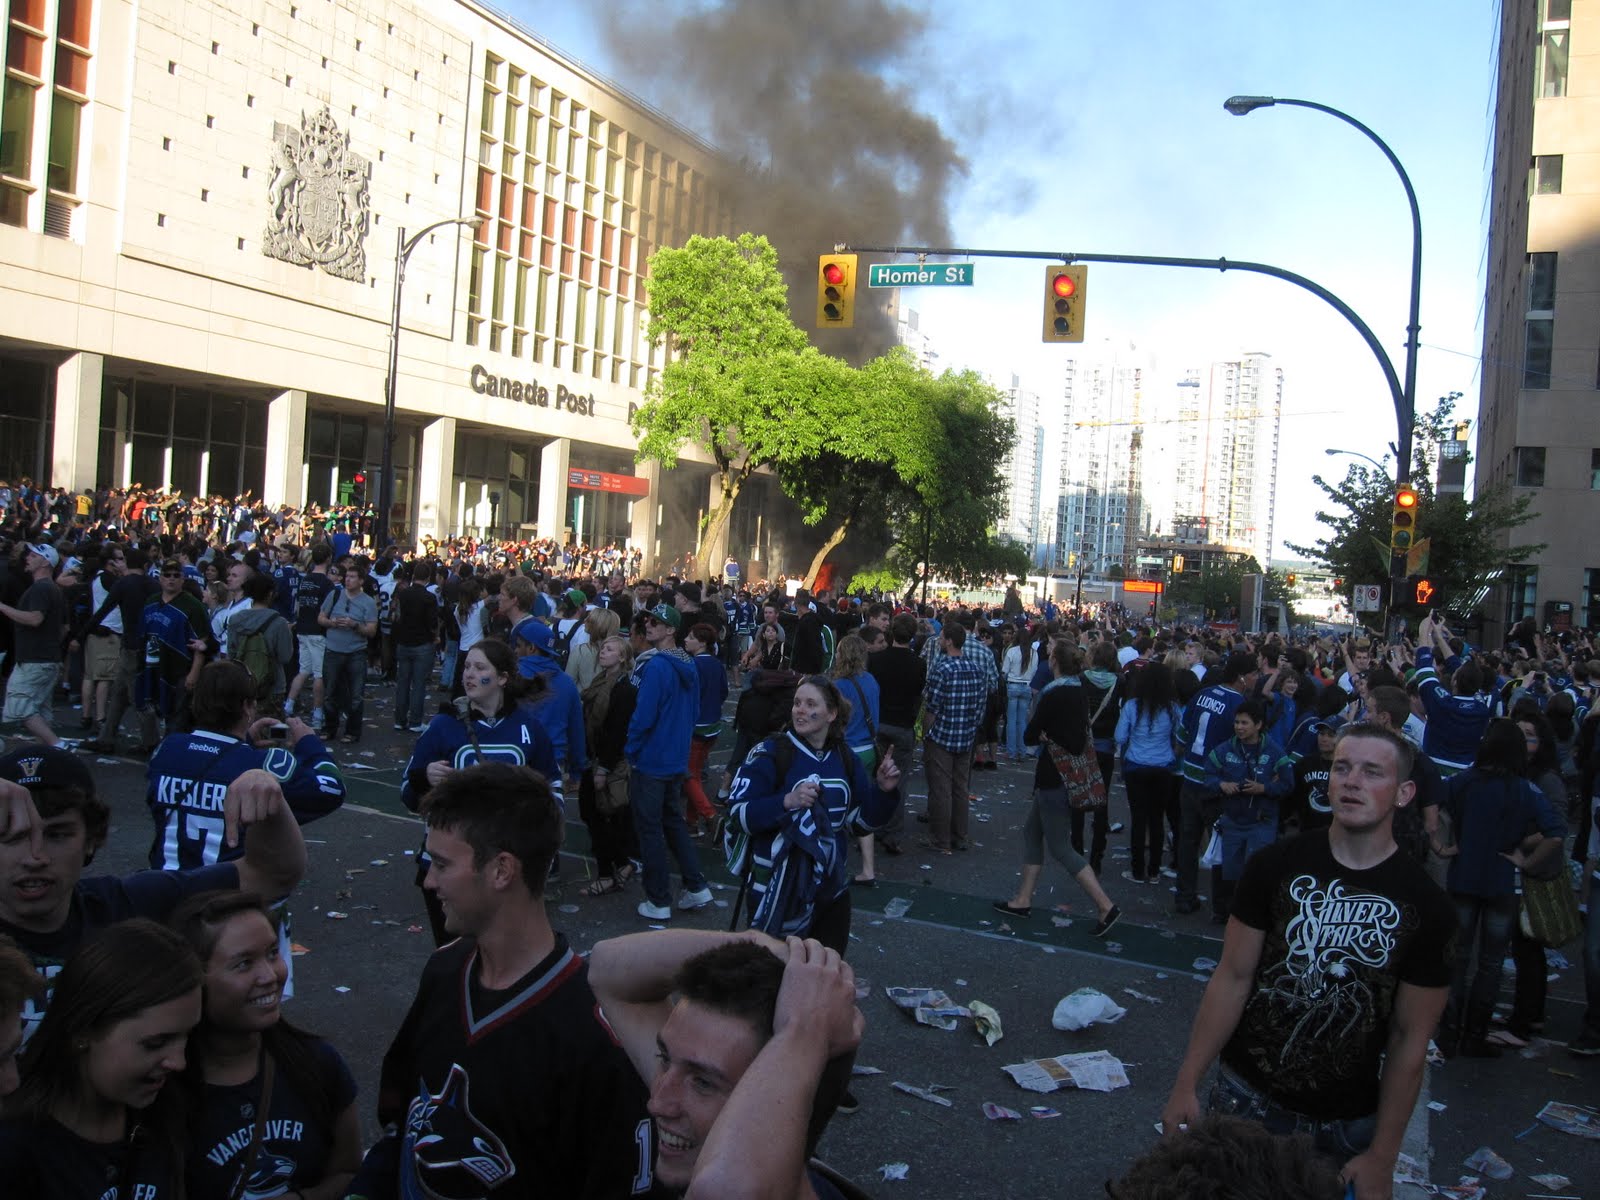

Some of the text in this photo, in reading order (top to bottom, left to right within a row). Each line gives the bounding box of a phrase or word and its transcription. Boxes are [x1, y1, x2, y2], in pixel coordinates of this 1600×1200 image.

[878, 267, 965, 284] Homer St
[471, 364, 549, 408] Canada
[555, 383, 596, 418] Post
[1196, 694, 1226, 715] LUONGO
[520, 724, 531, 745] A
[1191, 711, 1211, 756] 1
[188, 741, 220, 755] Reebok
[1304, 771, 1330, 783] VANCO
[157, 774, 227, 812] KESLER
[162, 808, 225, 872] 17
